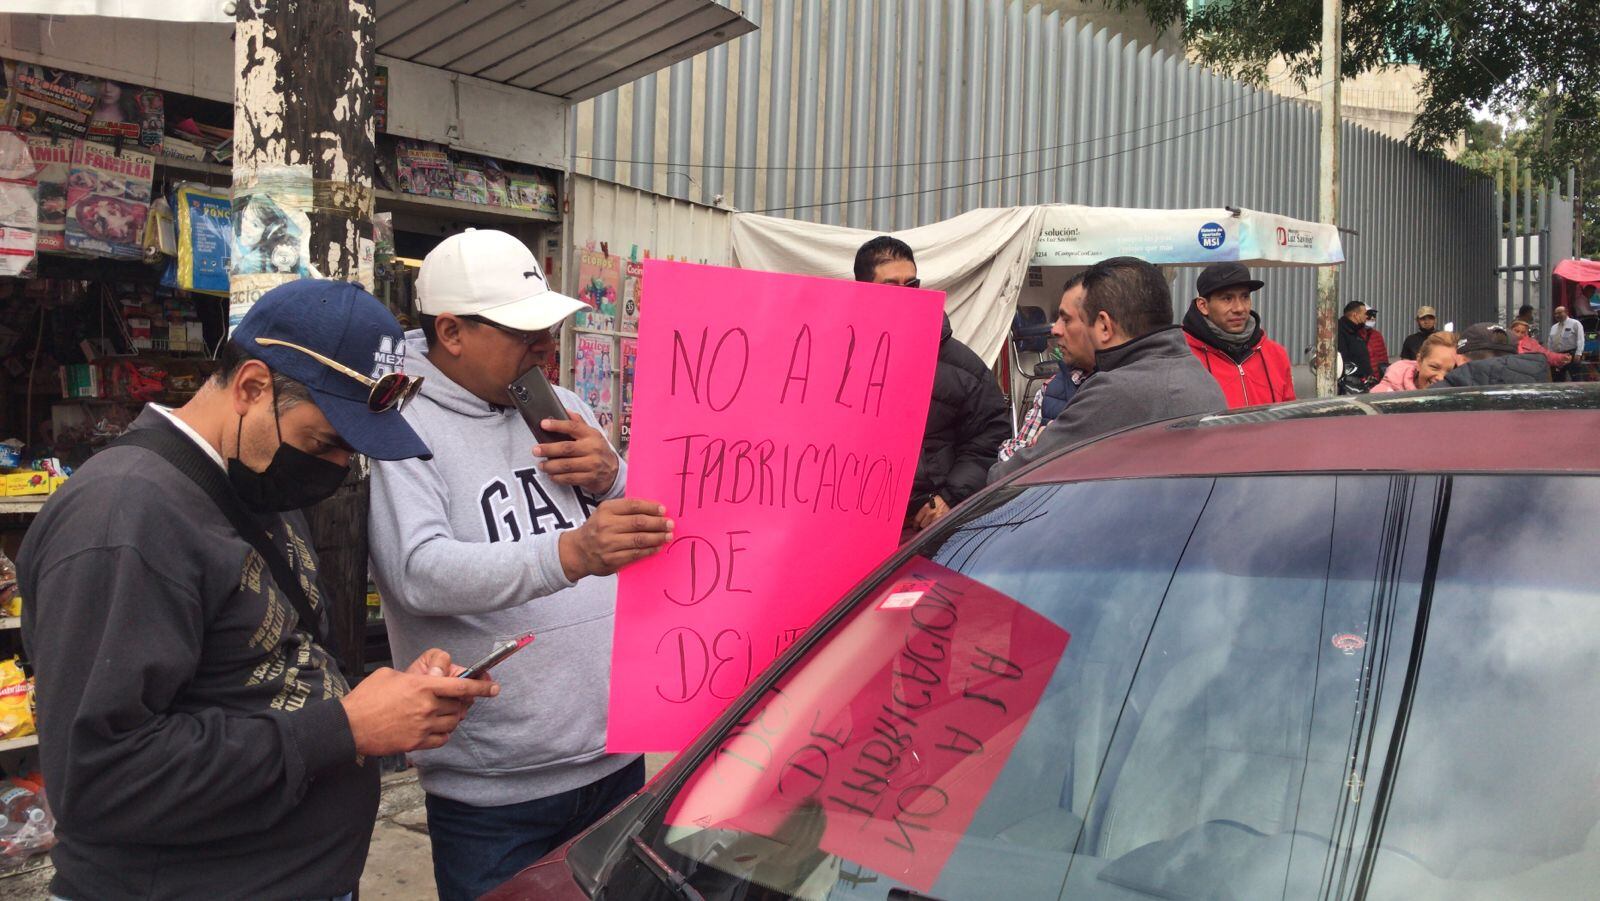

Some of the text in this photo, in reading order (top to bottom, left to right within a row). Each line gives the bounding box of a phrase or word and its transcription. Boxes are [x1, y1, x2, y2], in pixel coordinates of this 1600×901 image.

[83, 152, 152, 180] FAMILIA
[1203, 238, 1220, 247] MSI
[670, 323, 891, 417] NO A LA
[662, 433, 907, 523] FABRICACION
[663, 530, 753, 607] DE
